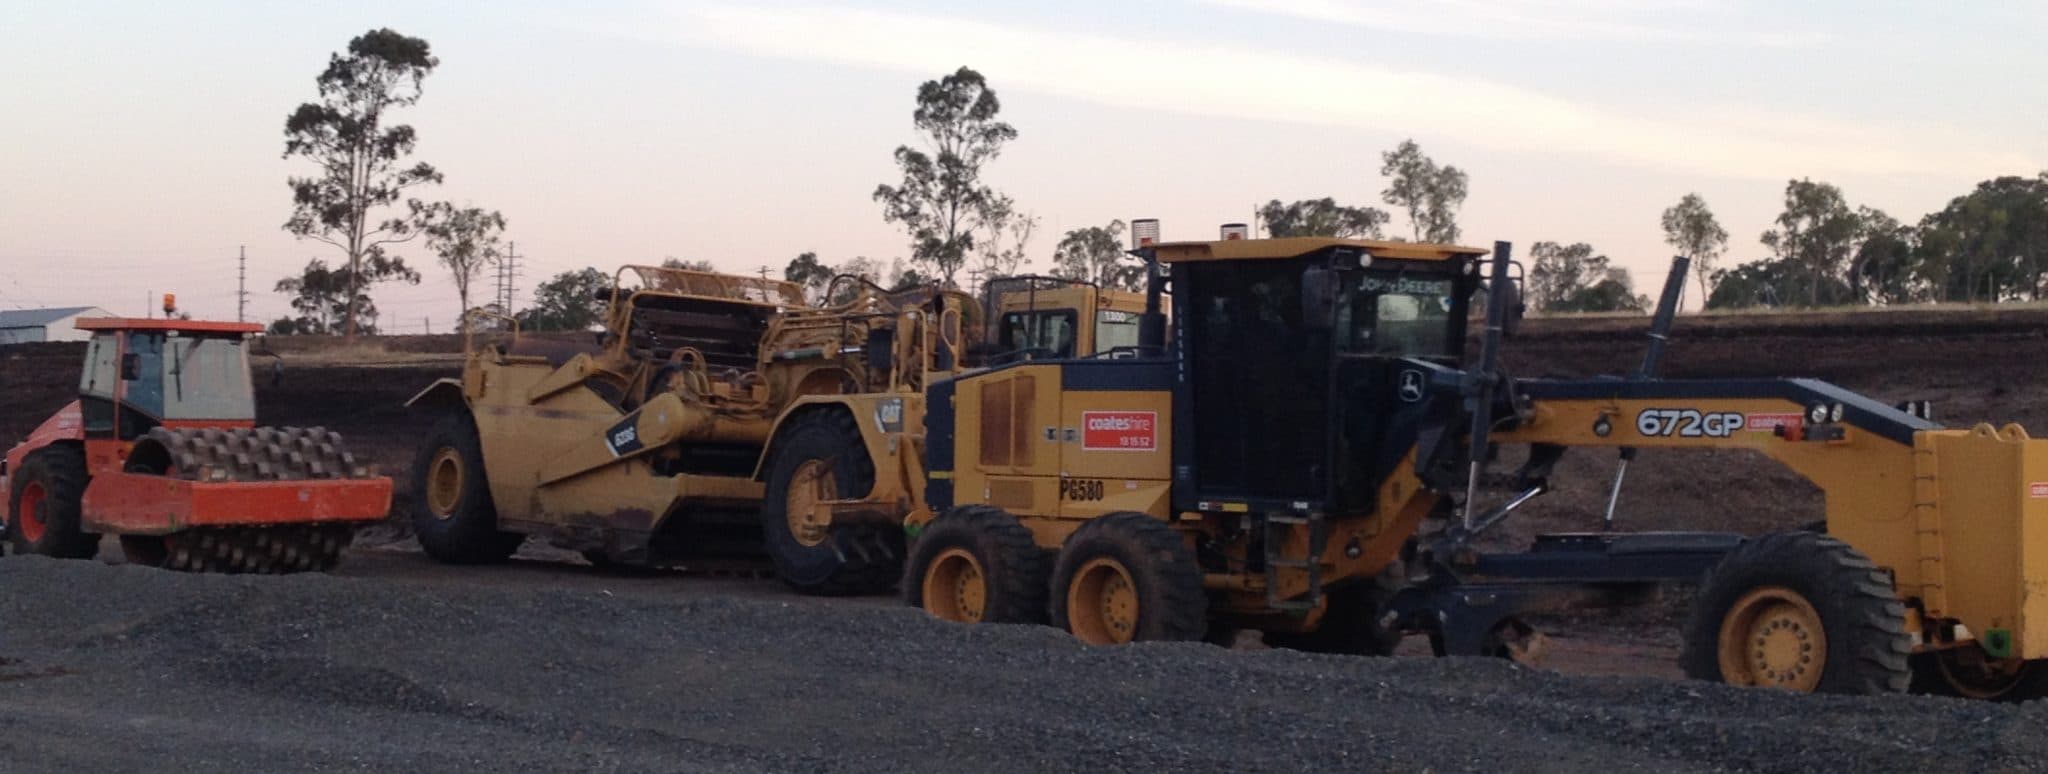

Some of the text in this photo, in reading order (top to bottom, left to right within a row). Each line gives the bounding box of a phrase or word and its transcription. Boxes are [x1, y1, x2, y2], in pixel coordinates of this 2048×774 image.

[1397, 278, 1442, 295] DEERE
[881, 398, 901, 423] CAT
[1637, 409, 1744, 437] 672GP
[1060, 480, 1104, 501] PG580
